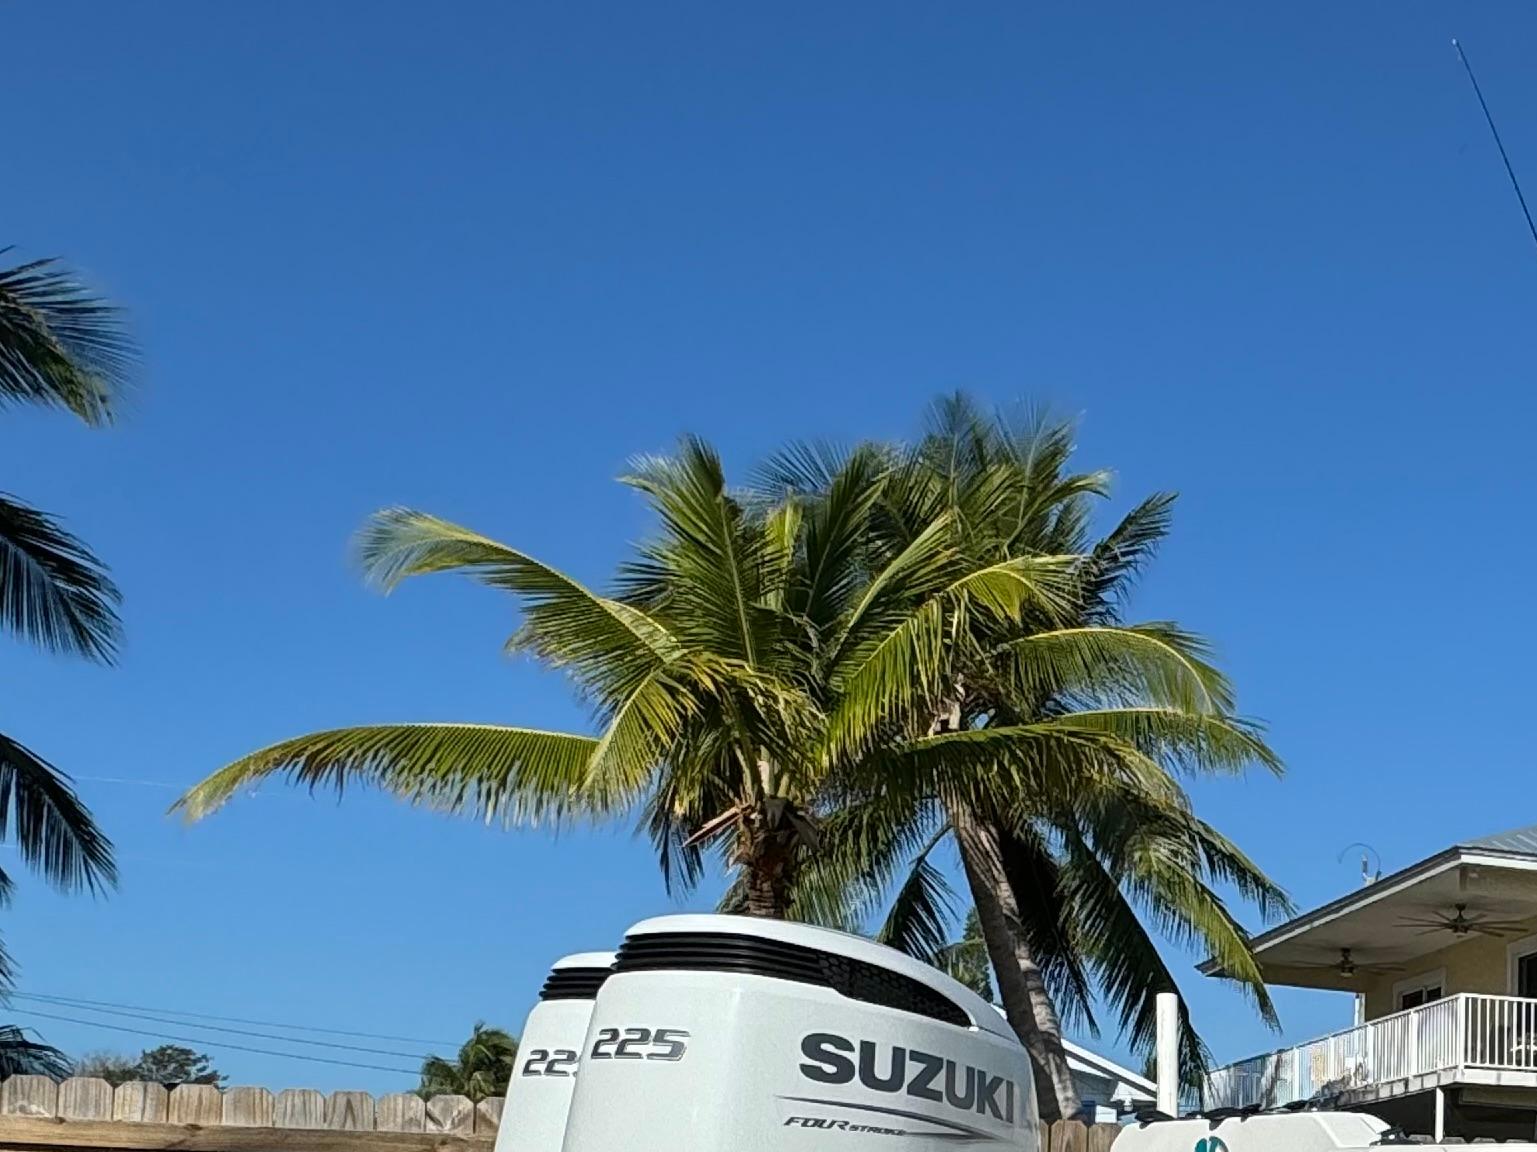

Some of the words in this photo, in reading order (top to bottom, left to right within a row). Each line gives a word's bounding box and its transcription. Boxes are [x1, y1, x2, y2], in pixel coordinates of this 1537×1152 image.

[591, 1028, 690, 1062] 225
[522, 1049, 579, 1078] 22
[799, 1033, 1013, 1124] SUZUKI
